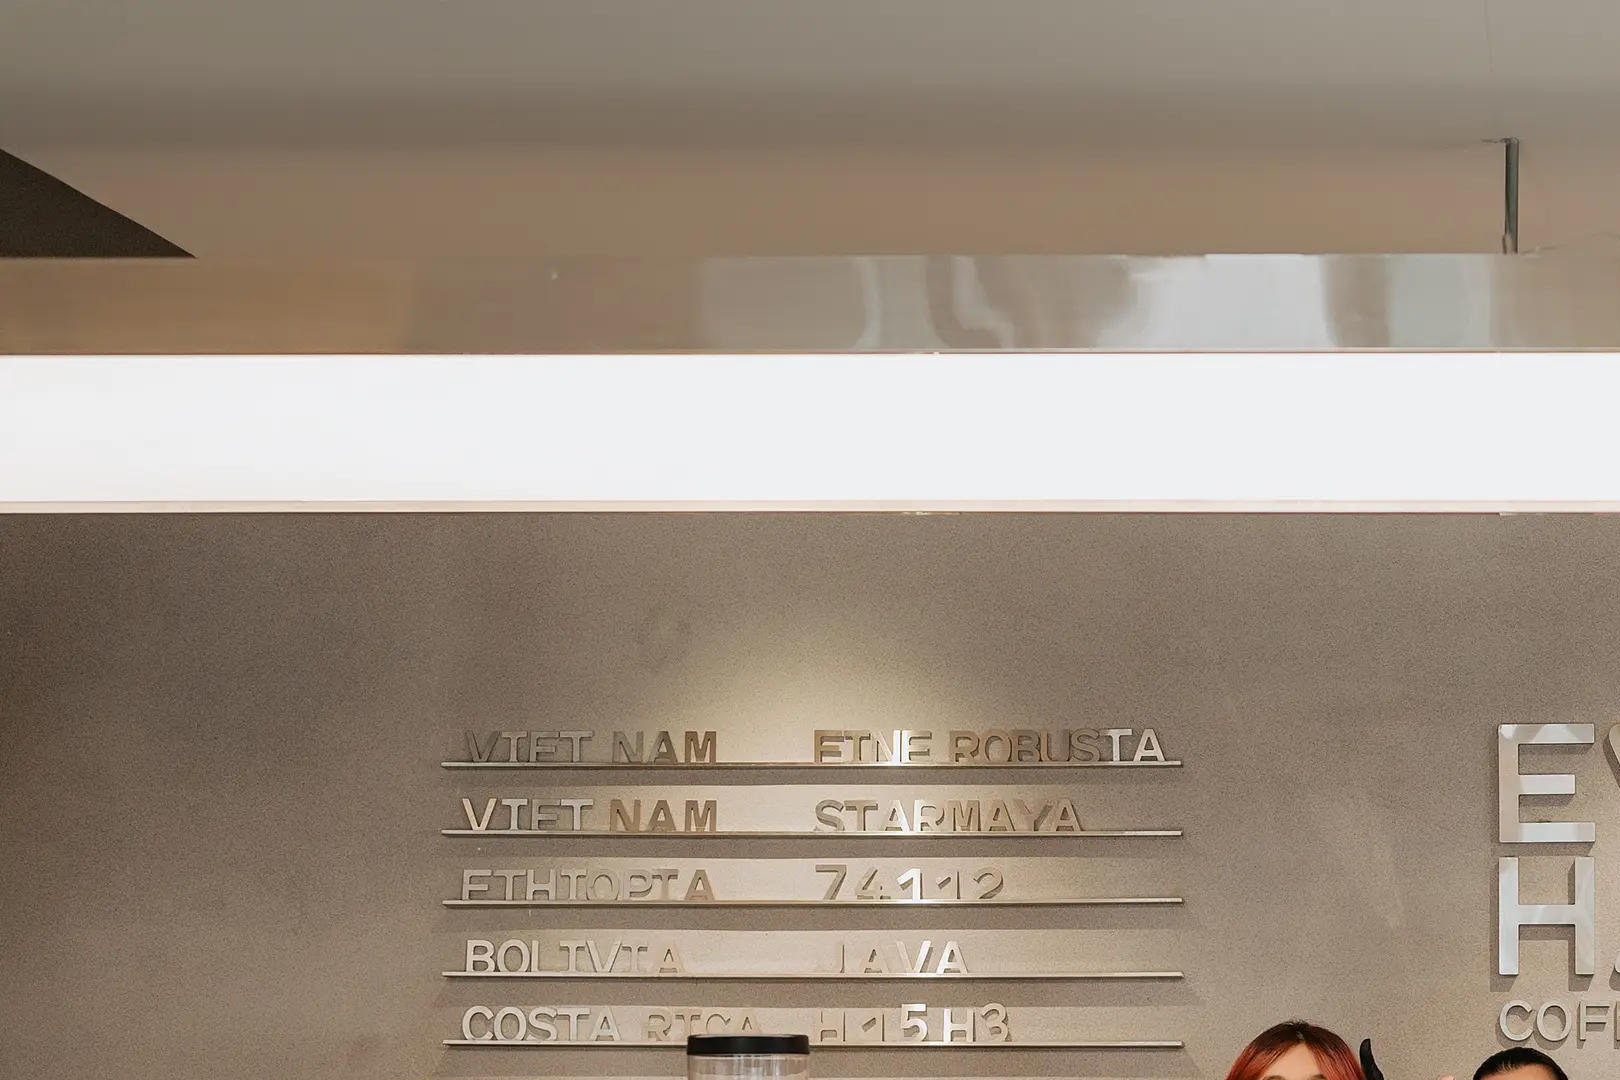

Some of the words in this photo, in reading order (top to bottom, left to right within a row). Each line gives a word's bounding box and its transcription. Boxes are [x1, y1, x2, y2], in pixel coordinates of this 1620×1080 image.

[464, 731, 594, 763] VIET
[613, 731, 717, 763] NAM
[949, 729, 1166, 763] ROBUSTA
[462, 798, 594, 831] VIET
[609, 799, 717, 831] NAM
[814, 799, 1084, 832] STARMAYA
[461, 869, 716, 901] ETHIOPIA
[815, 865, 1005, 901] 74112
[465, 939, 686, 973] BOLIVIA
[462, 1005, 622, 1042] COSTA
[641, 1009, 760, 1042] RICA
